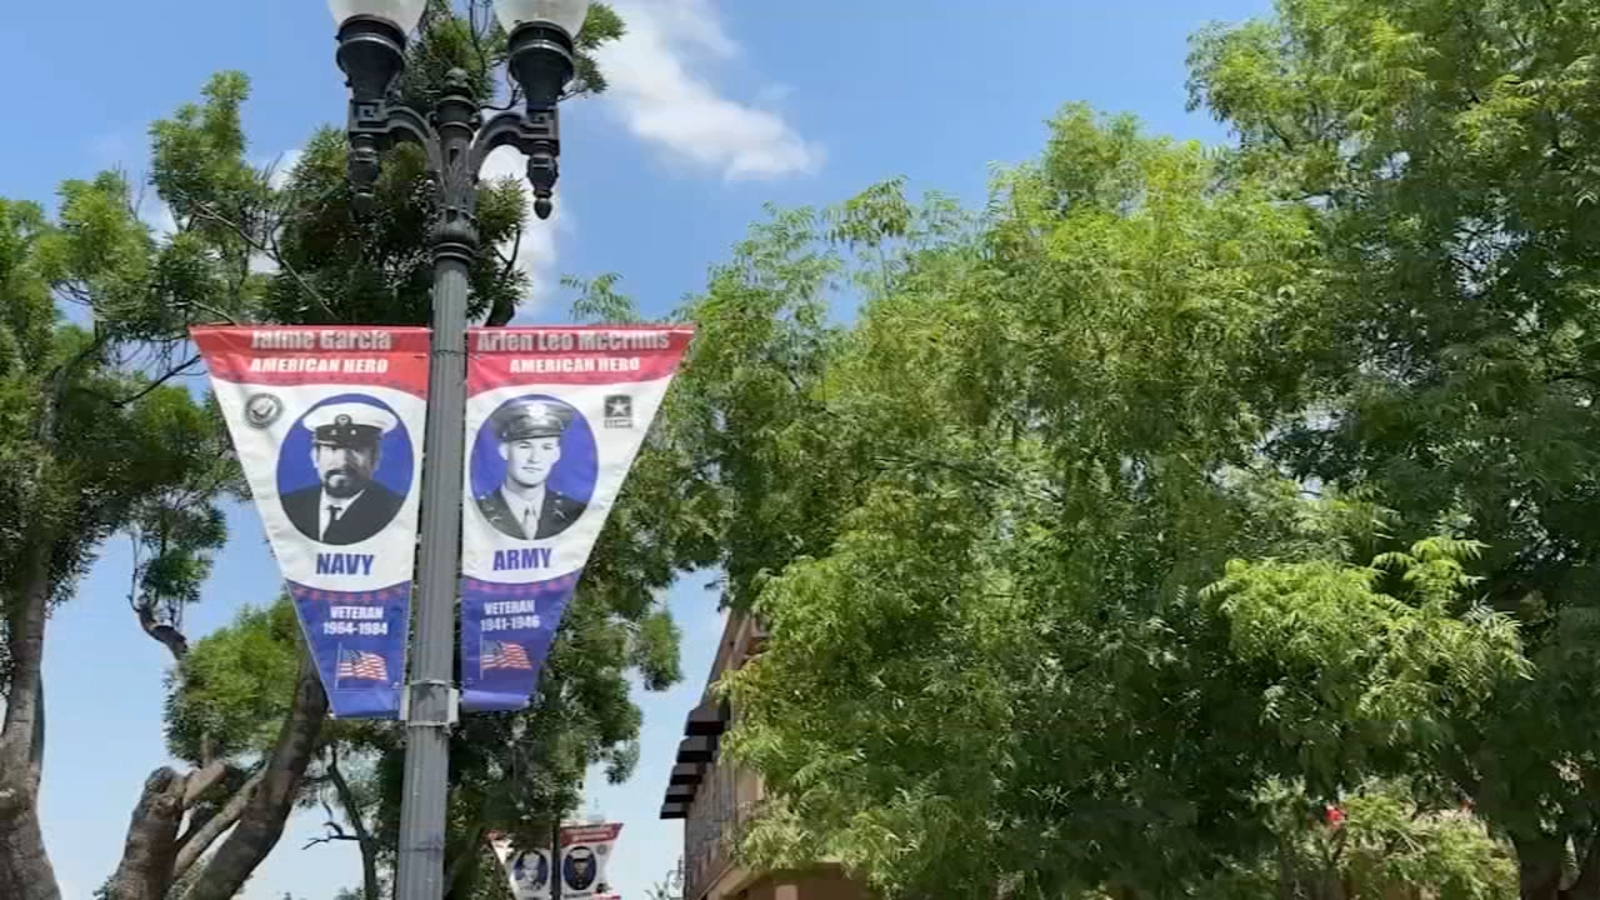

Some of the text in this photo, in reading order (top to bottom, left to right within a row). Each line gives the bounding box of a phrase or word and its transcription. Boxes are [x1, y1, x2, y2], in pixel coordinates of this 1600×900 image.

[251, 330, 391, 350] Jaime Garcia
[538, 330, 573, 351] Leo
[249, 358, 388, 373] AMERICAN HERO
[510, 357, 640, 374] AMERICAN HERO
[316, 553, 375, 575] NAVY
[493, 548, 552, 571] ARMY
[330, 606, 384, 620] VETERAN
[484, 600, 535, 615] VETERAN
[480, 615, 541, 632] 1941-1946
